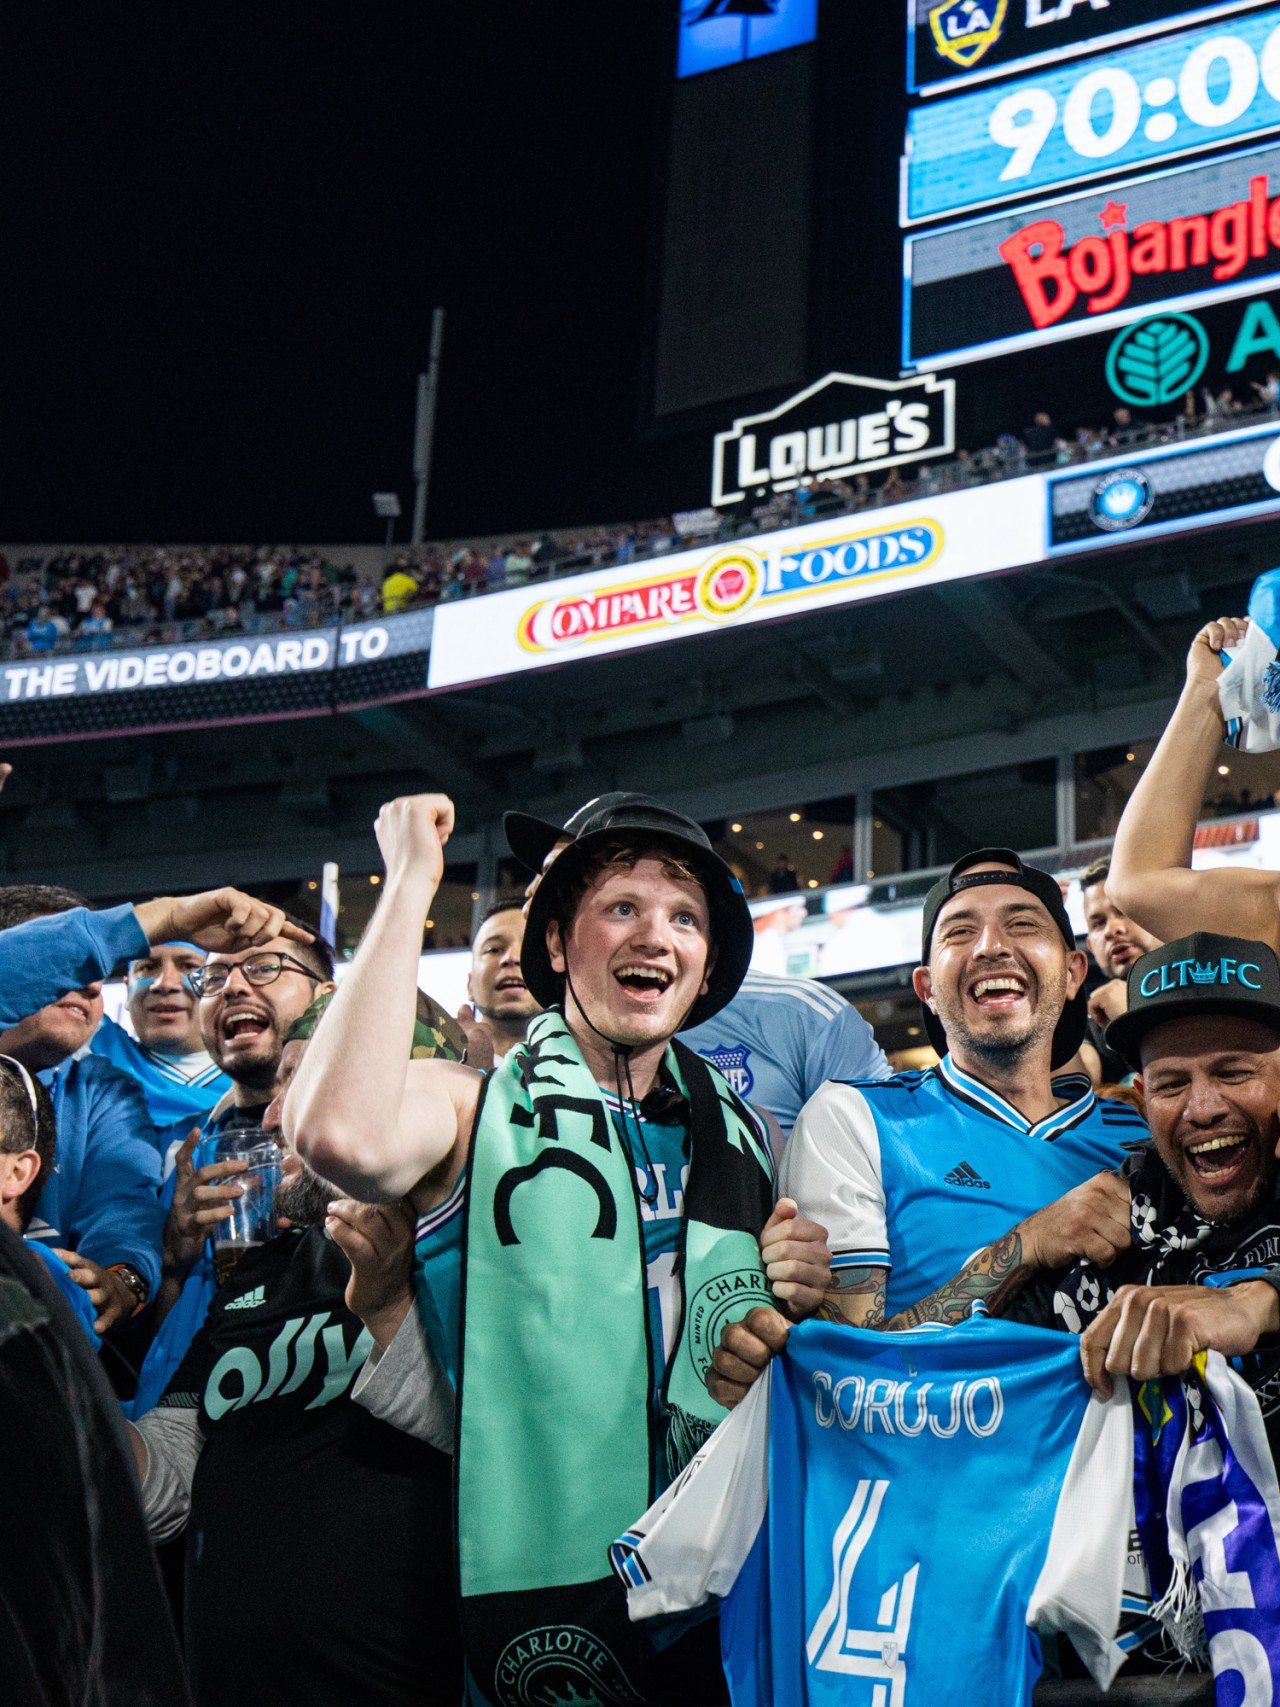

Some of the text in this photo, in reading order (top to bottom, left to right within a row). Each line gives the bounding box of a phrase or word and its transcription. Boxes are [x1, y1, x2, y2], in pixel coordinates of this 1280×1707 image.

[947, 9, 992, 37] LA
[738, 400, 930, 488] LOWE'S
[532, 577, 696, 649] COMPARE
[765, 527, 927, 591] FOODS
[5, 627, 389, 699] THE VIDEOBOARD TO
[944, 1177, 991, 1189] adidas
[695, 1306, 705, 1344] MINTED
[203, 1311, 375, 1421] ally
[811, 1370, 1005, 1438] CORUJO
[501, 1631, 608, 1685] CHARLOTTE
